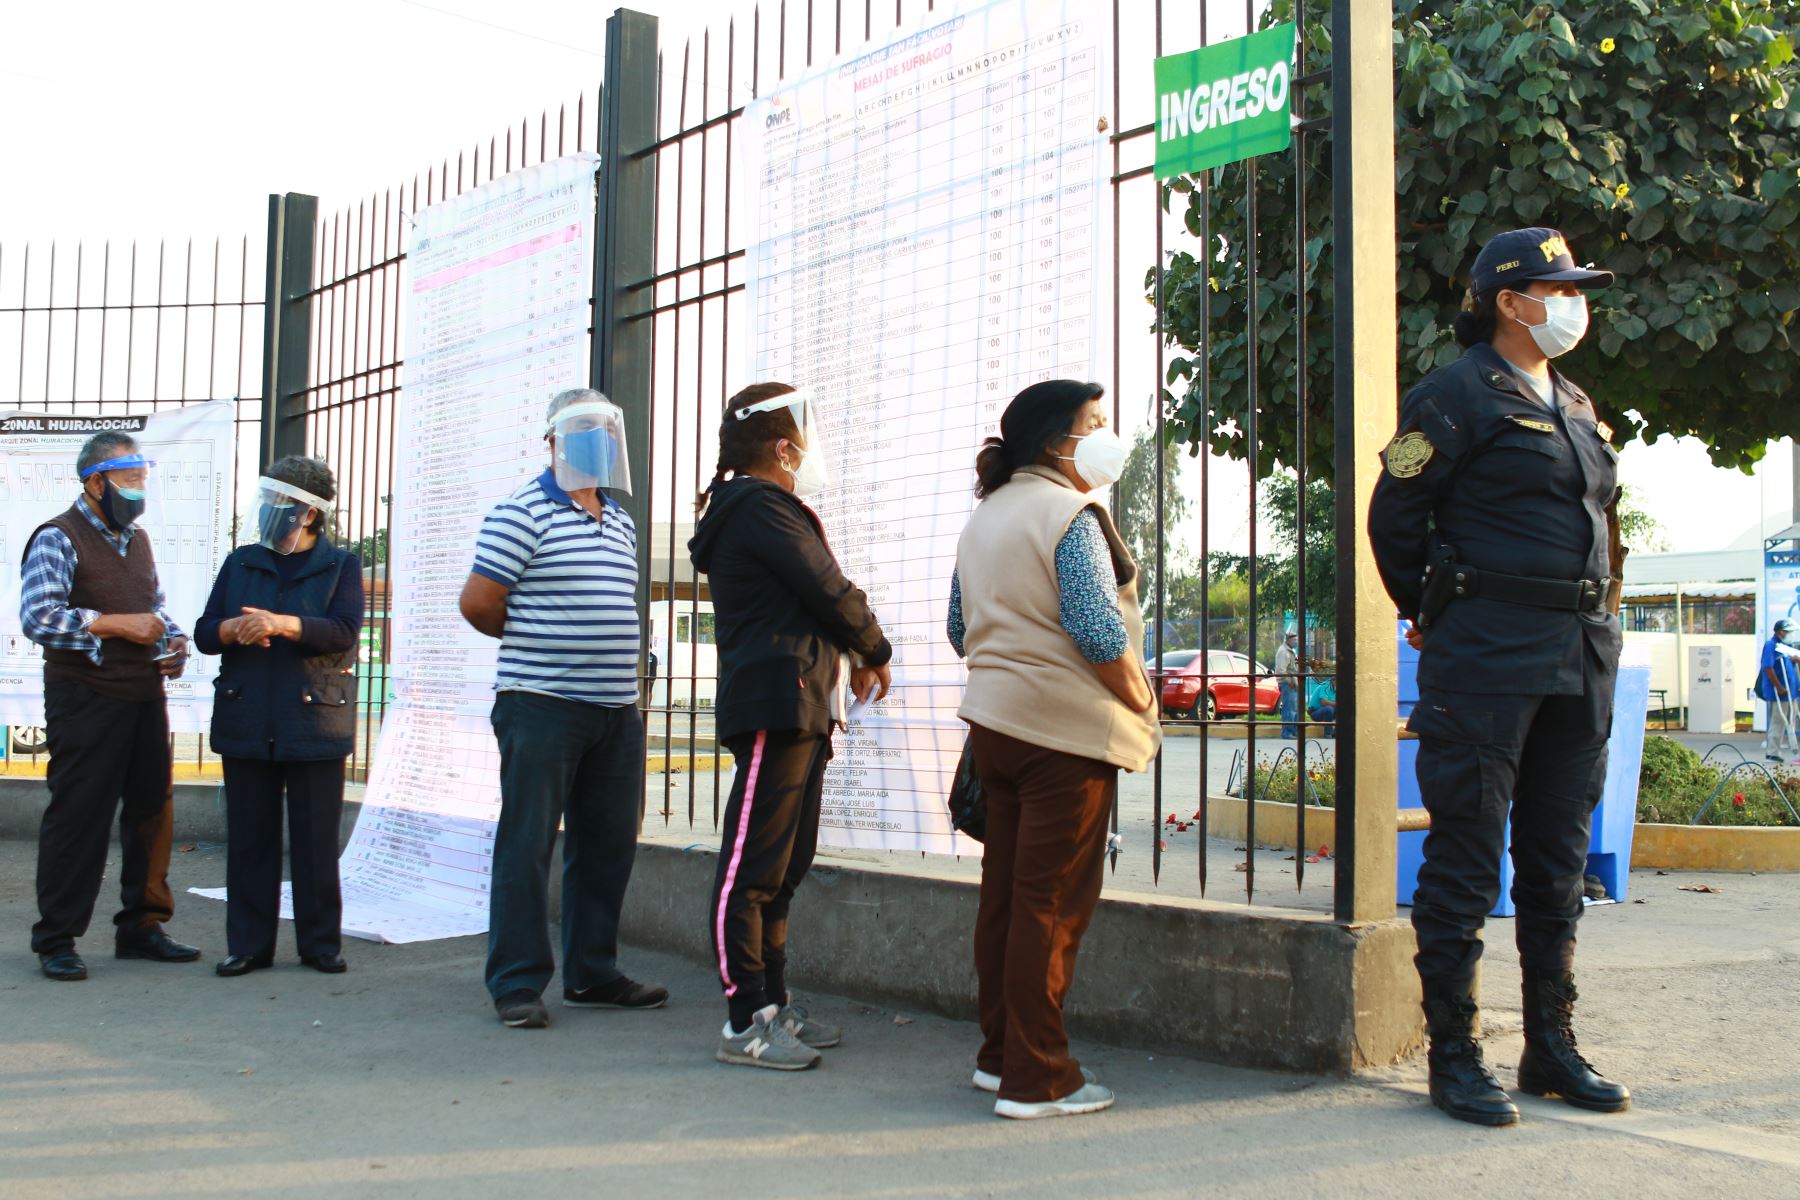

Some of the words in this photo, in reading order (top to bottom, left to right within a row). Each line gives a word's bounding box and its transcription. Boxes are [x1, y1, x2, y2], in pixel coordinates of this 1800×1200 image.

[854, 72, 883, 94] MESAS
[886, 66, 898, 80] DE
[902, 42, 952, 74] SUFRAGIO
[1043, 64, 1056, 73] Aula
[992, 104, 1004, 114] 100
[1044, 87, 1056, 97] 101
[1160, 60, 1288, 143] INGRESO
[766, 107, 790, 129] ONPE
[1044, 108, 1056, 118] 102
[992, 146, 1003, 156] 100
[1043, 129, 1054, 140] 103
[992, 167, 1003, 177] 100
[1042, 151, 1054, 162] 104
[990, 188, 1002, 198] 100
[1042, 172, 1053, 183] 104
[990, 210, 1002, 219] 100
[1041, 194, 1053, 204] 105
[990, 230, 1002, 240] 100
[1040, 215, 1052, 226] 106
[989, 252, 1002, 262] 100
[1040, 238, 1052, 248] 106
[989, 273, 1002, 283] 100
[1040, 260, 1052, 270] 107
[1496, 260, 1520, 273] PERU
[988, 295, 1001, 304] 100
[1040, 282, 1052, 292] 108
[1039, 305, 1051, 314] 109
[988, 338, 1000, 348] 100
[1039, 327, 1051, 337] 110
[987, 360, 999, 369] 100
[1038, 350, 1050, 359] 111
[1038, 372, 1050, 381] 112
[2, 420, 44, 431] ZONAL
[48, 419, 140, 431] HUIRACOCHA
[213, 547, 219, 556] DE
[834, 739, 856, 747] PASTOR,
[858, 739, 878, 747] VIRGINIA
[856, 750, 872, 758] ORTIZ,
[827, 769, 848, 777] QUISPE,
[823, 779, 843, 787] RRERO,
[825, 798, 846, 807] ZUÑIGA,
[834, 810, 852, 818] LOPEZ,
[854, 810, 878, 818] ENRIQUE
[844, 820, 866, 828] WALTER
[866, 820, 902, 829] WENDESLAO
[744, 1037, 770, 1058] N
